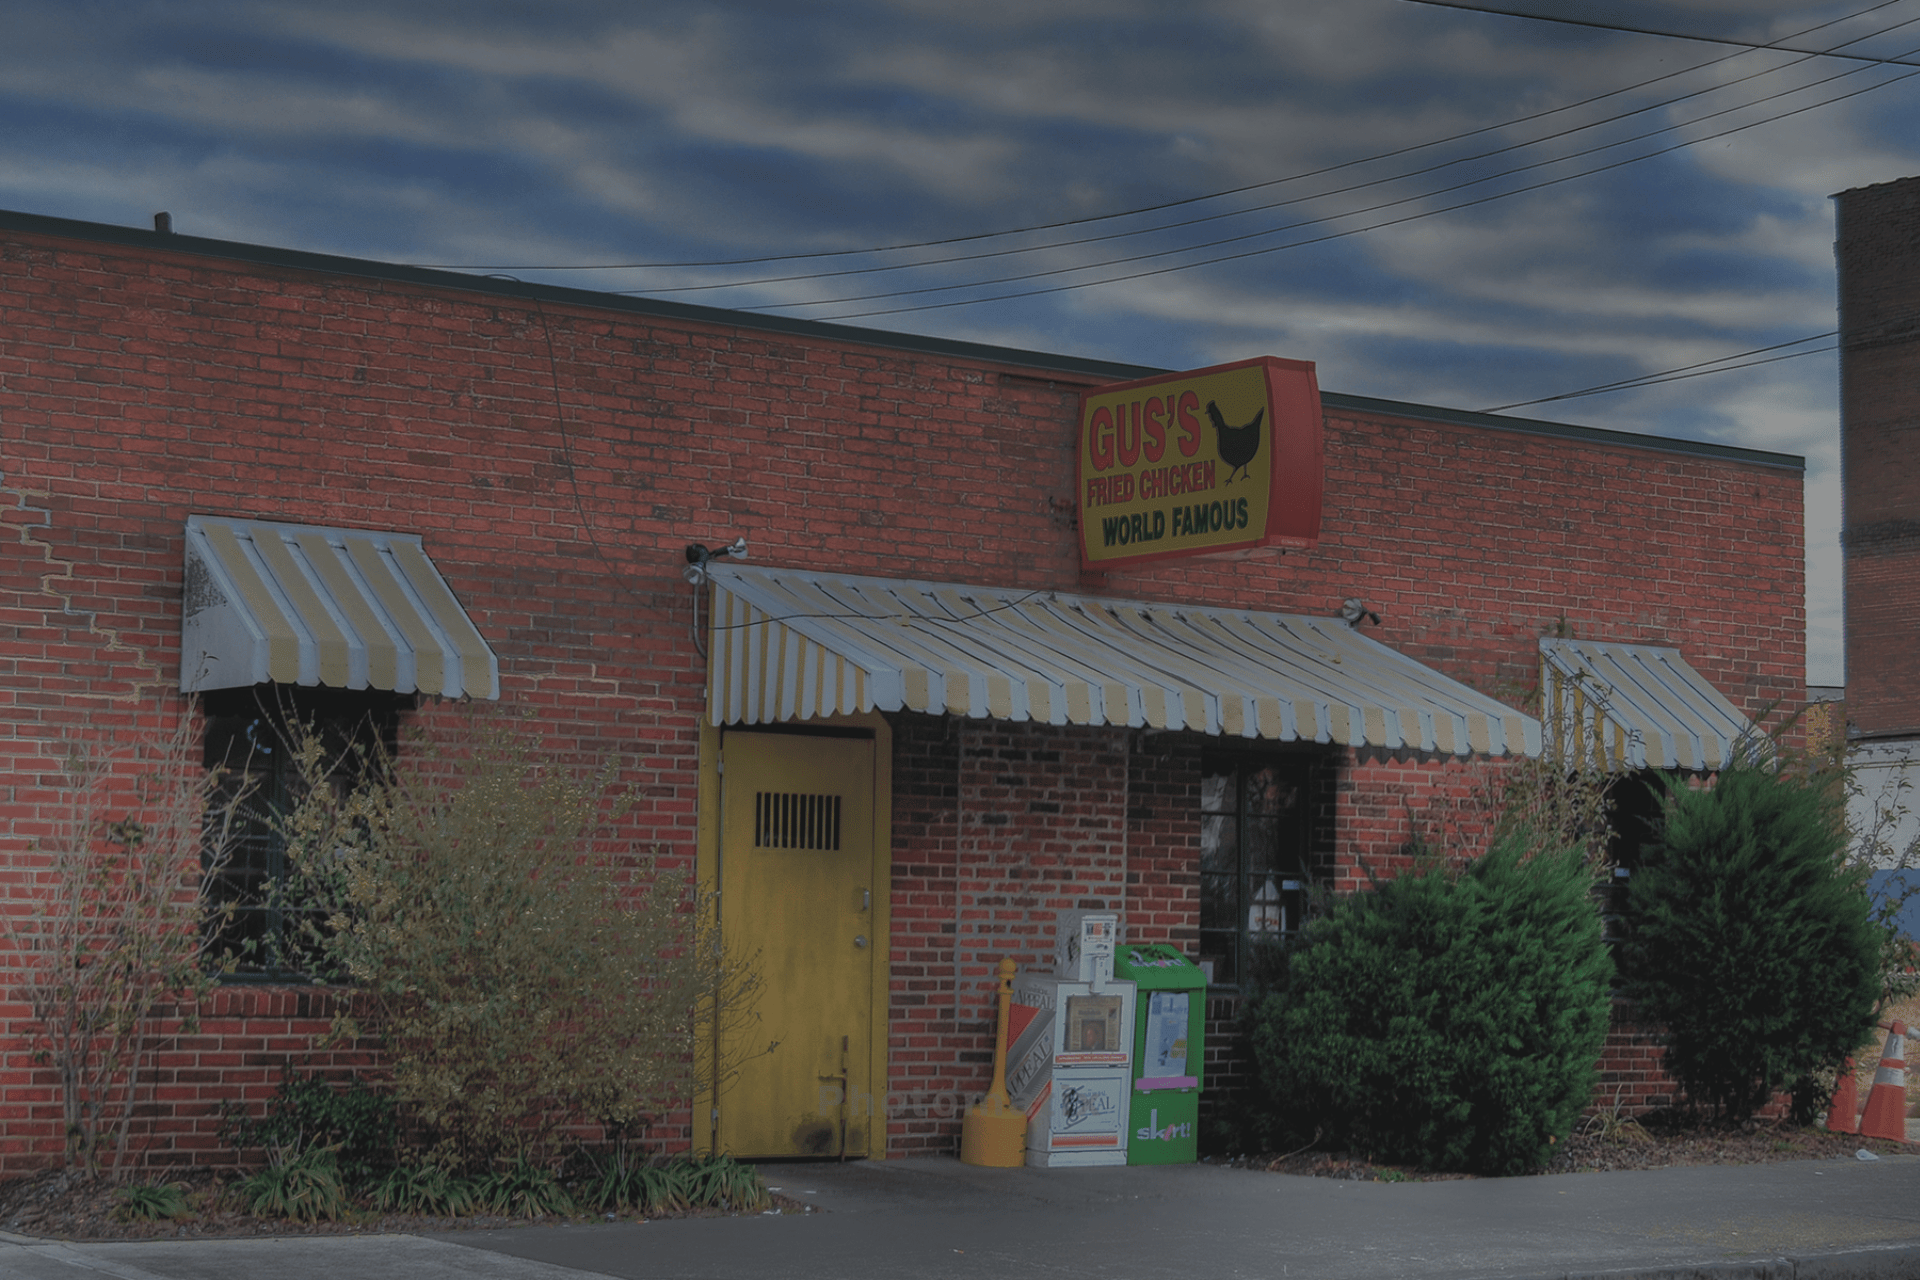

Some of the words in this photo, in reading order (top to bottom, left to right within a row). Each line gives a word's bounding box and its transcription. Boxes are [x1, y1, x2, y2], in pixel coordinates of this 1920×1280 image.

[1089, 390, 1201, 471] GUS'S
[1087, 473, 1135, 508] FRIED
[1139, 460, 1215, 500] CHICKEN
[1102, 510, 1165, 547] WORLD
[1172, 497, 1248, 537] FAMOUS
